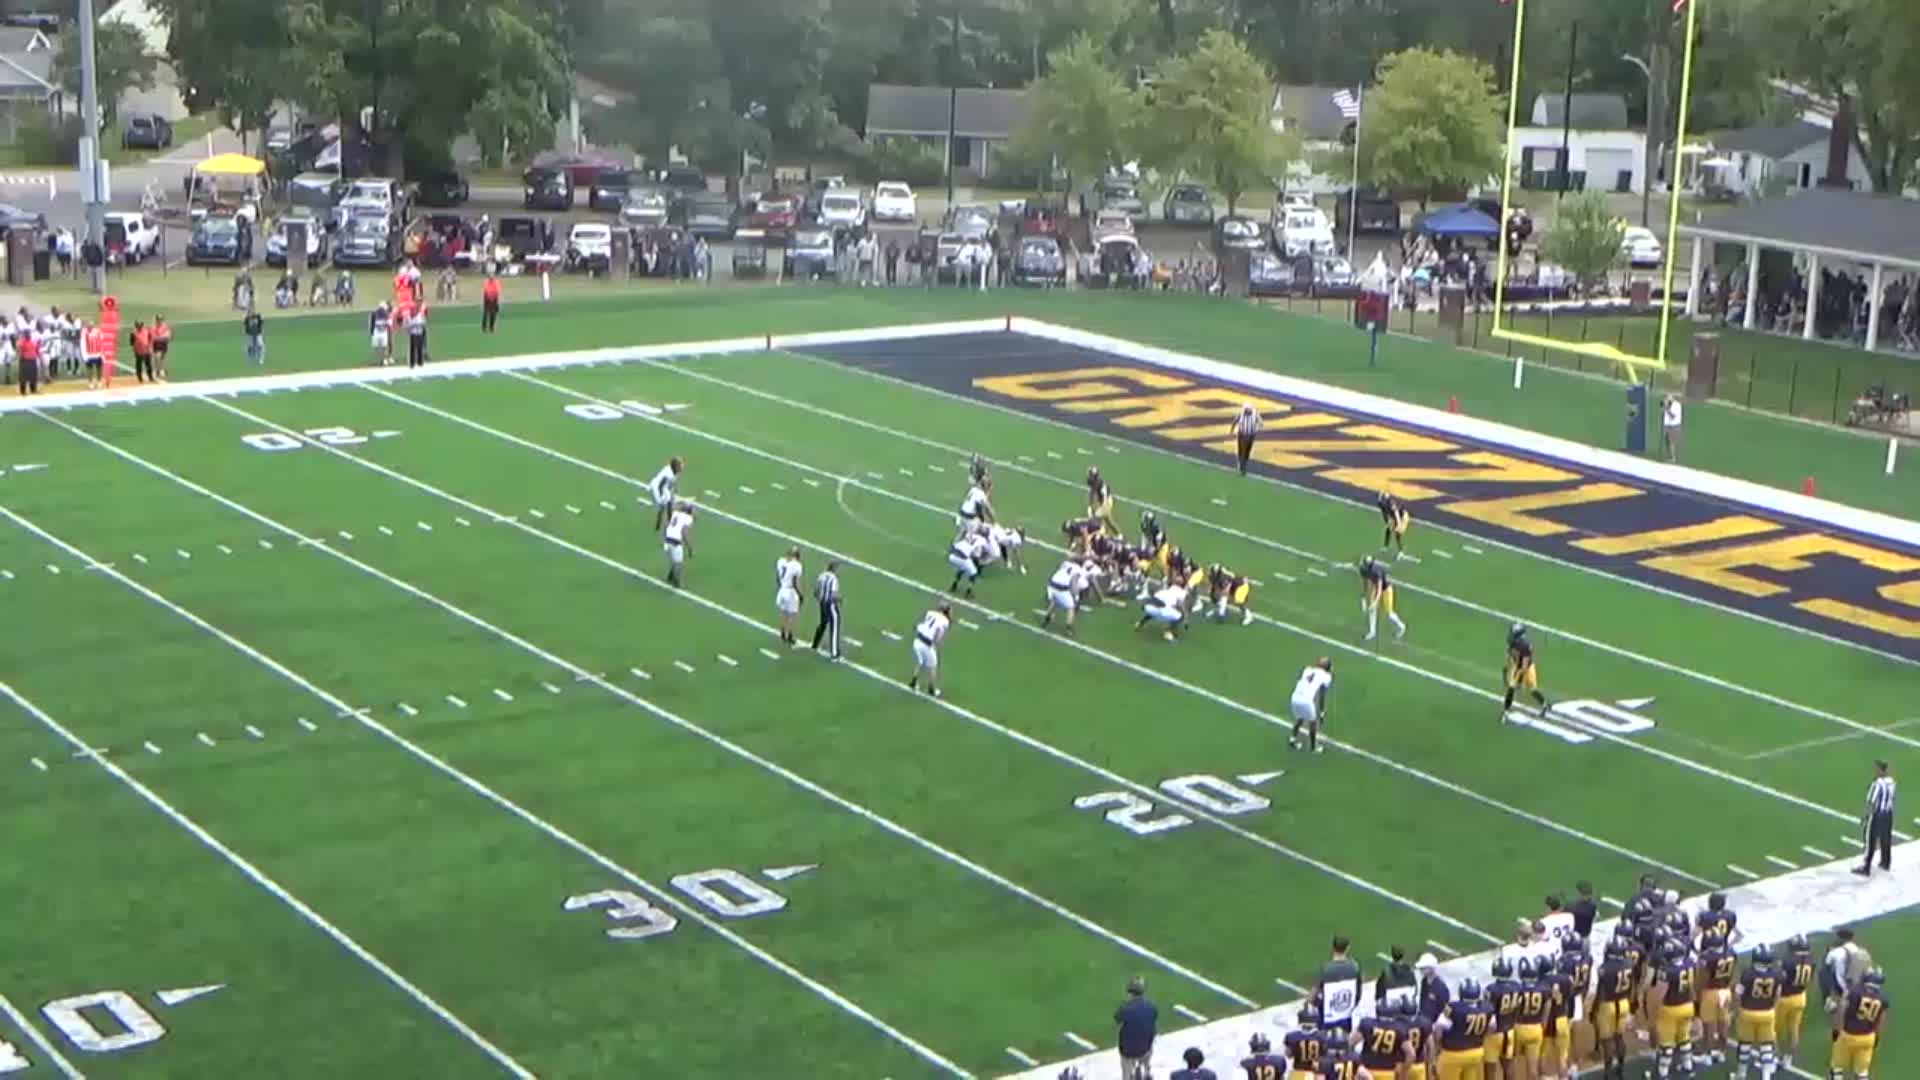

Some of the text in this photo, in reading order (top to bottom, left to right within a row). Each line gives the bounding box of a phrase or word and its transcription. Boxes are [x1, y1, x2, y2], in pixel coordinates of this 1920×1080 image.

[241, 426, 368, 450] 20
[1504, 699, 1655, 743] 10
[1074, 774, 1270, 834] 20
[564, 869, 788, 938] 30
[1793, 964, 1811, 985] 10
[1752, 977, 1775, 998] 63
[1522, 991, 1543, 1014] 19
[1856, 997, 1881, 1021] 50
[1464, 1013, 1488, 1036] 70
[1372, 1027, 1396, 1052] 79
